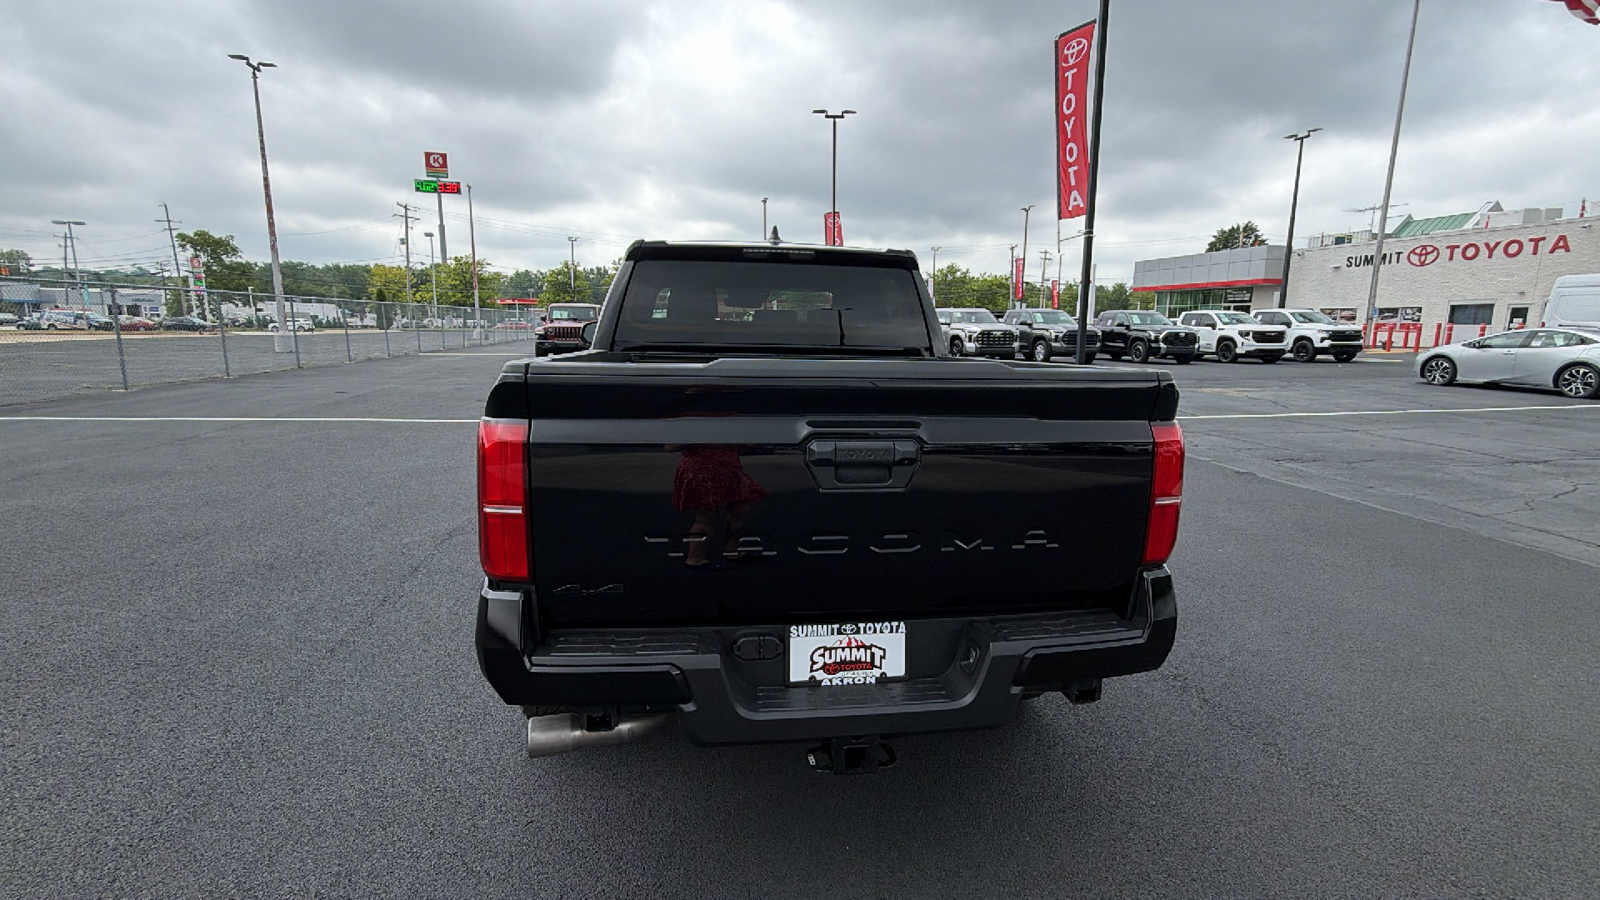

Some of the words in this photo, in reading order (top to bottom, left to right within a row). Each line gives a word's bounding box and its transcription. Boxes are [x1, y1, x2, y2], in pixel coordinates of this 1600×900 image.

[1062, 68, 1084, 210] TOYOTA
[1346, 252, 1403, 268] SUMMIT
[1446, 235, 1571, 261] TOYOTA
[790, 624, 839, 638] SUMMIT
[858, 621, 906, 635] TOYOTA
[840, 663, 872, 671] TOYOTA
[820, 676, 876, 686] AKRON
